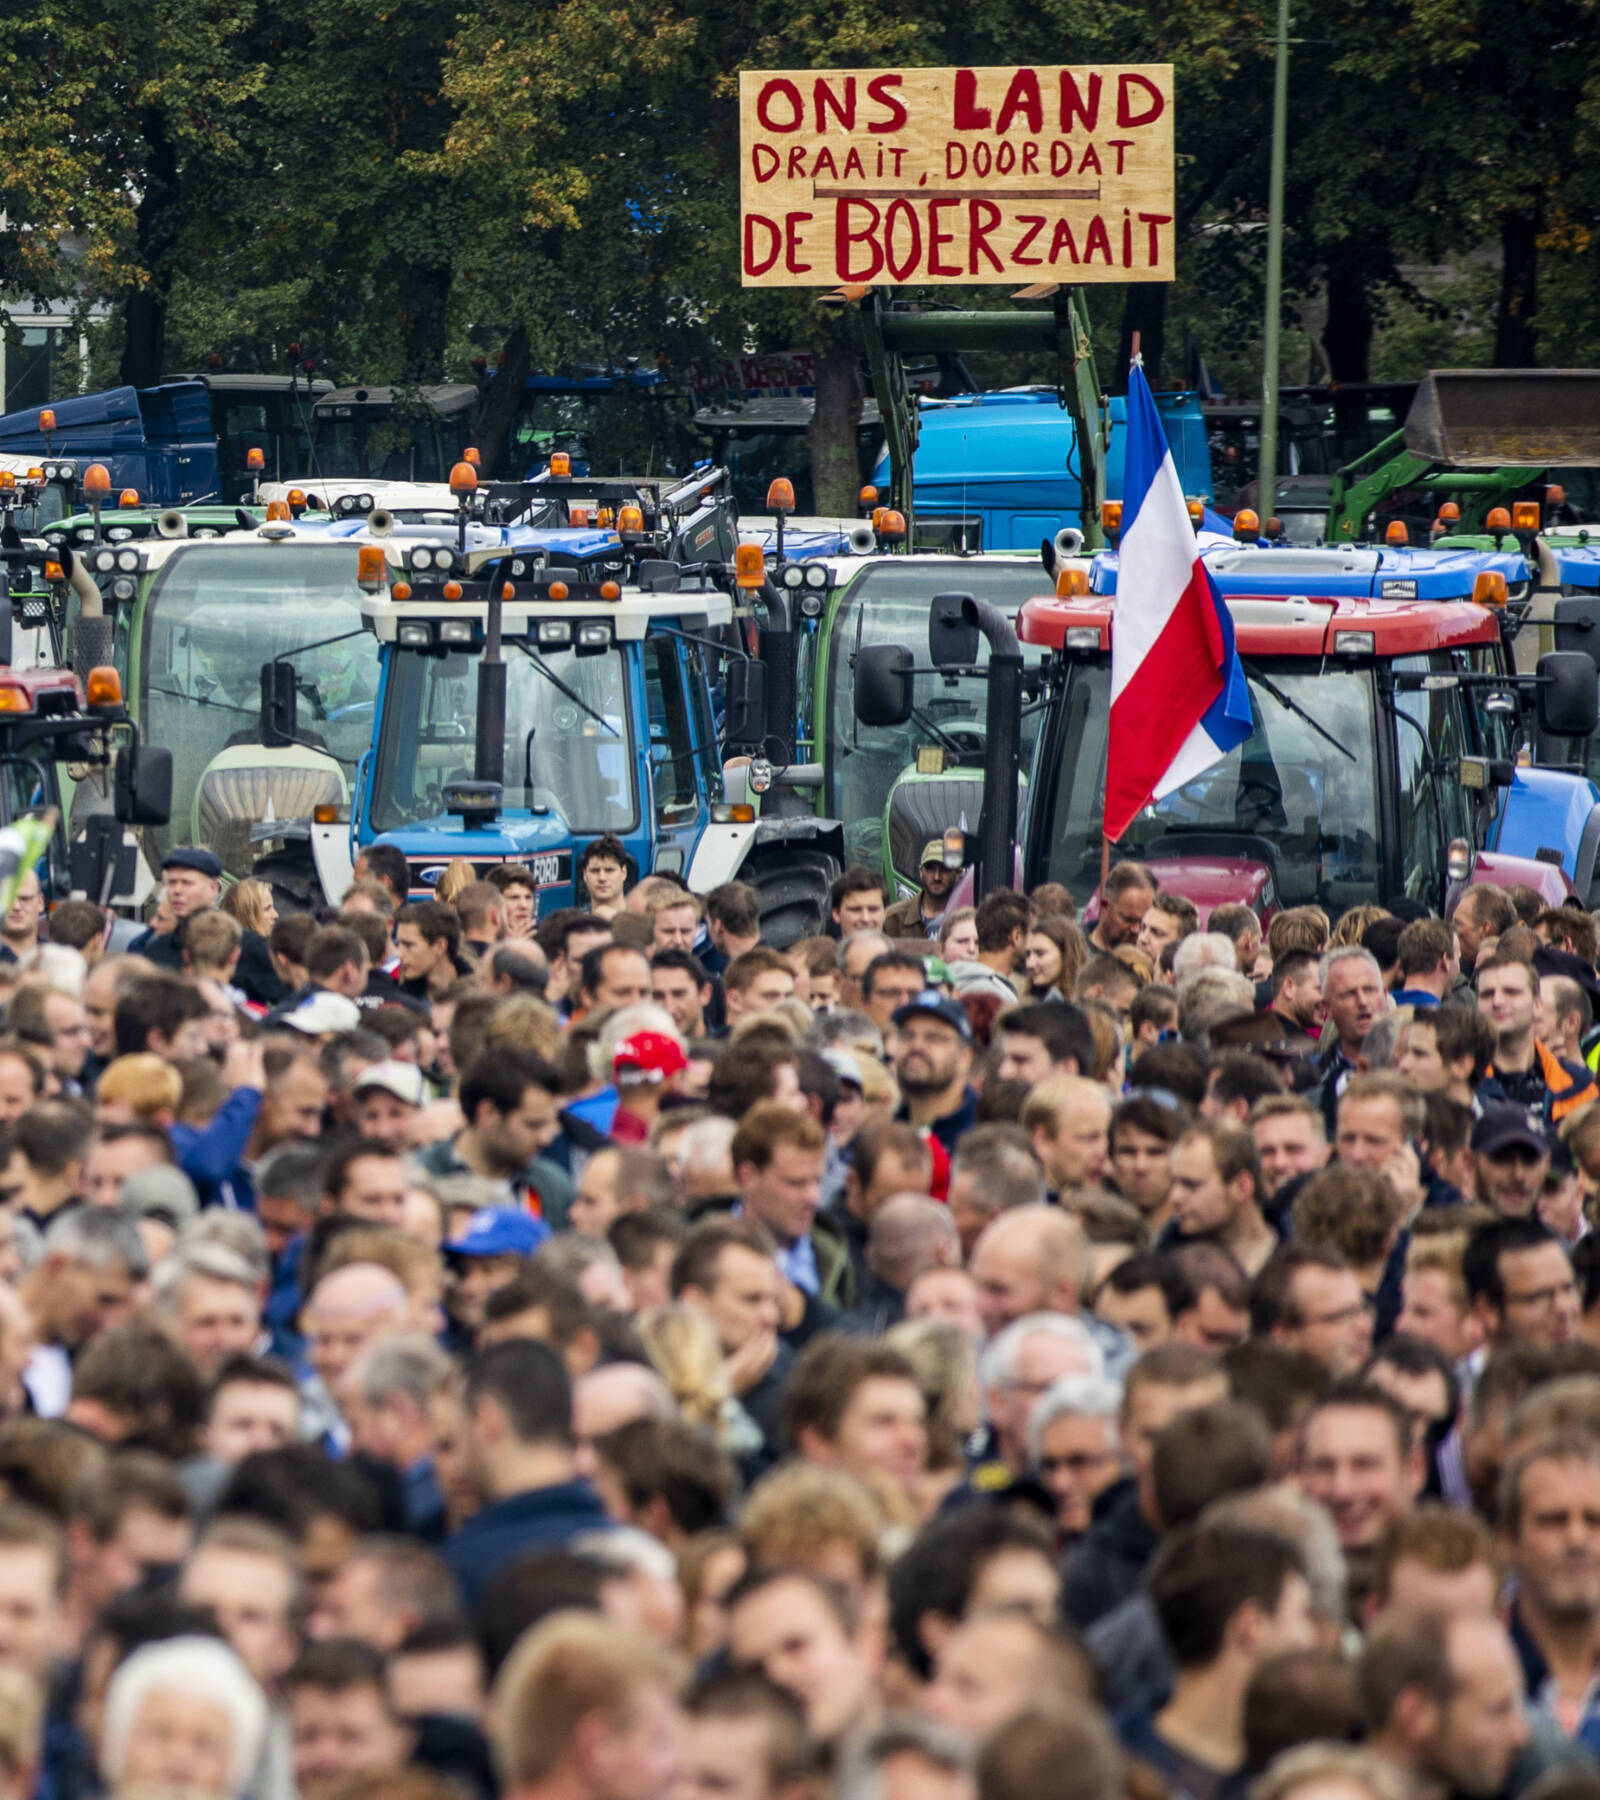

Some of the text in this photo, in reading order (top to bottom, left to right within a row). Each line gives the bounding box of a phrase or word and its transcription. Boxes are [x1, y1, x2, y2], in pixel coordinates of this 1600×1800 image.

[757, 68, 1165, 135] ONS LAND
[946, 140, 1135, 179] DOORDAT
[744, 212, 813, 276] DE
[534, 856, 559, 884] FORD
